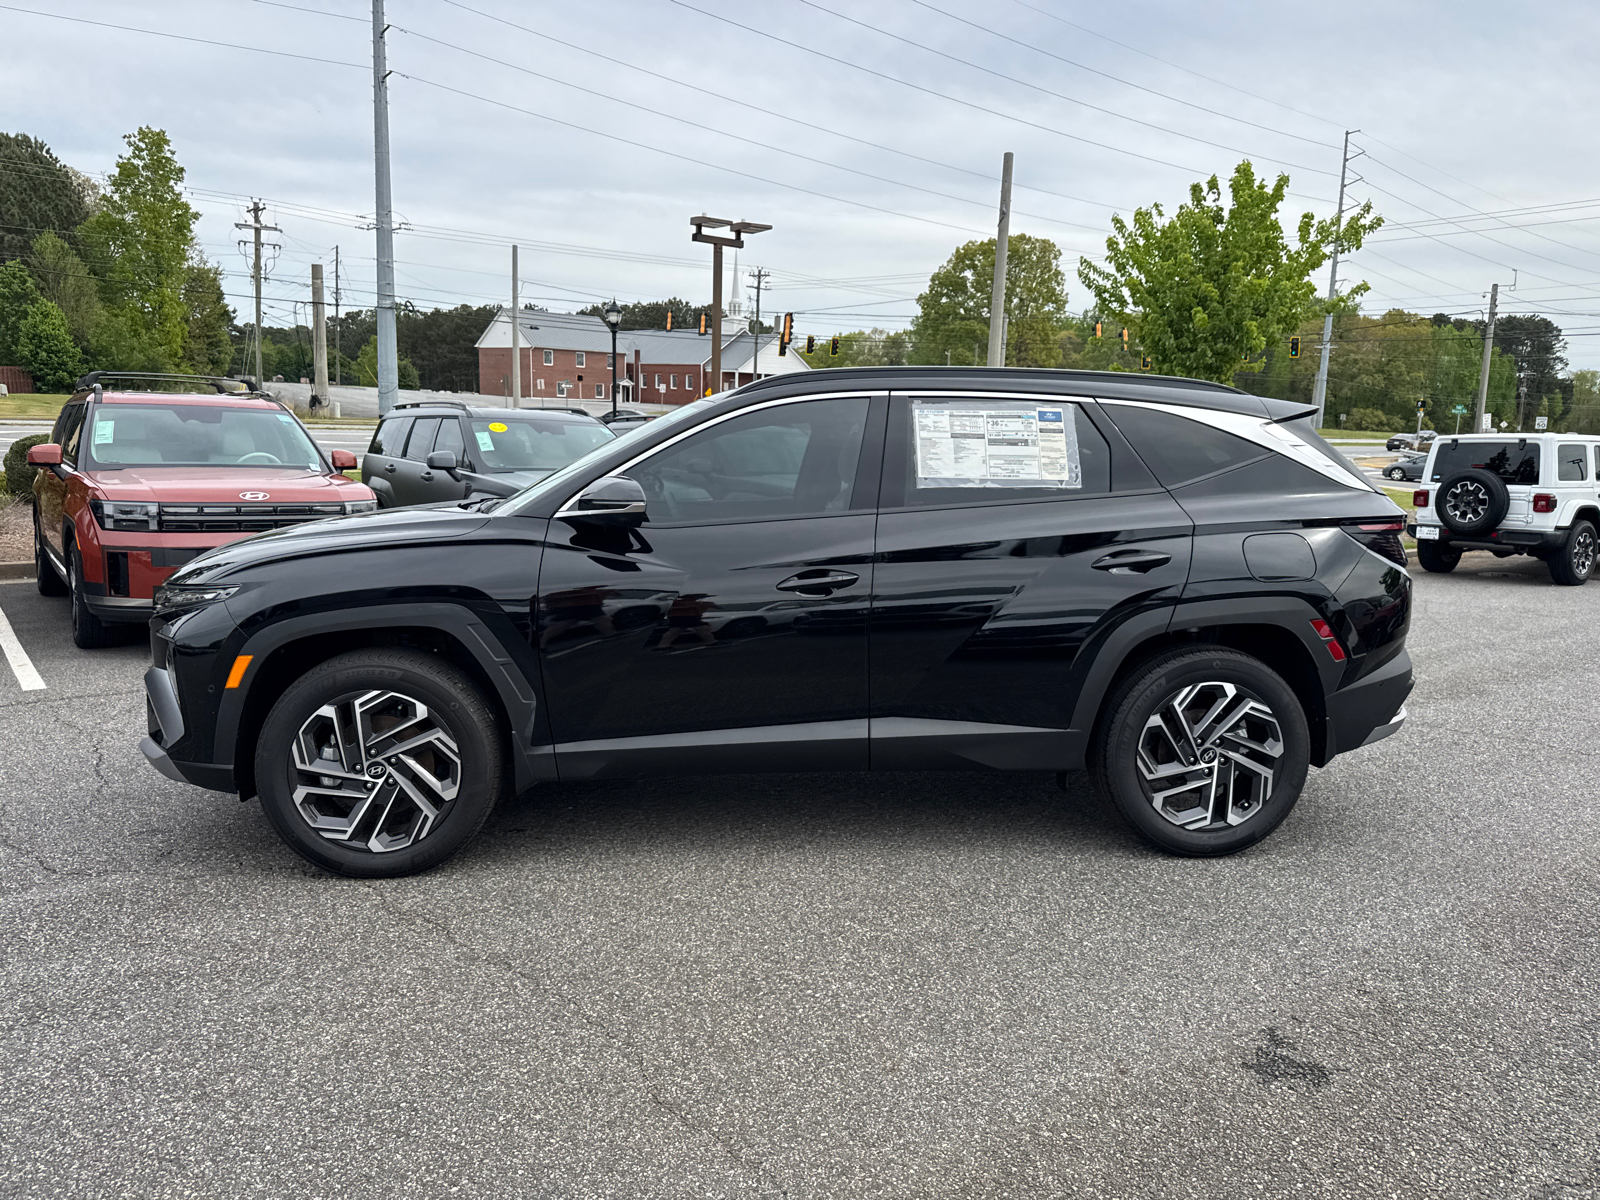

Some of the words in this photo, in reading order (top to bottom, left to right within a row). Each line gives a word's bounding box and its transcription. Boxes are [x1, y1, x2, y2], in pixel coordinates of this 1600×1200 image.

[345, 670, 376, 678] 235/55
[1132, 694, 1150, 718] 235/55
[1155, 682, 1162, 690] 19
